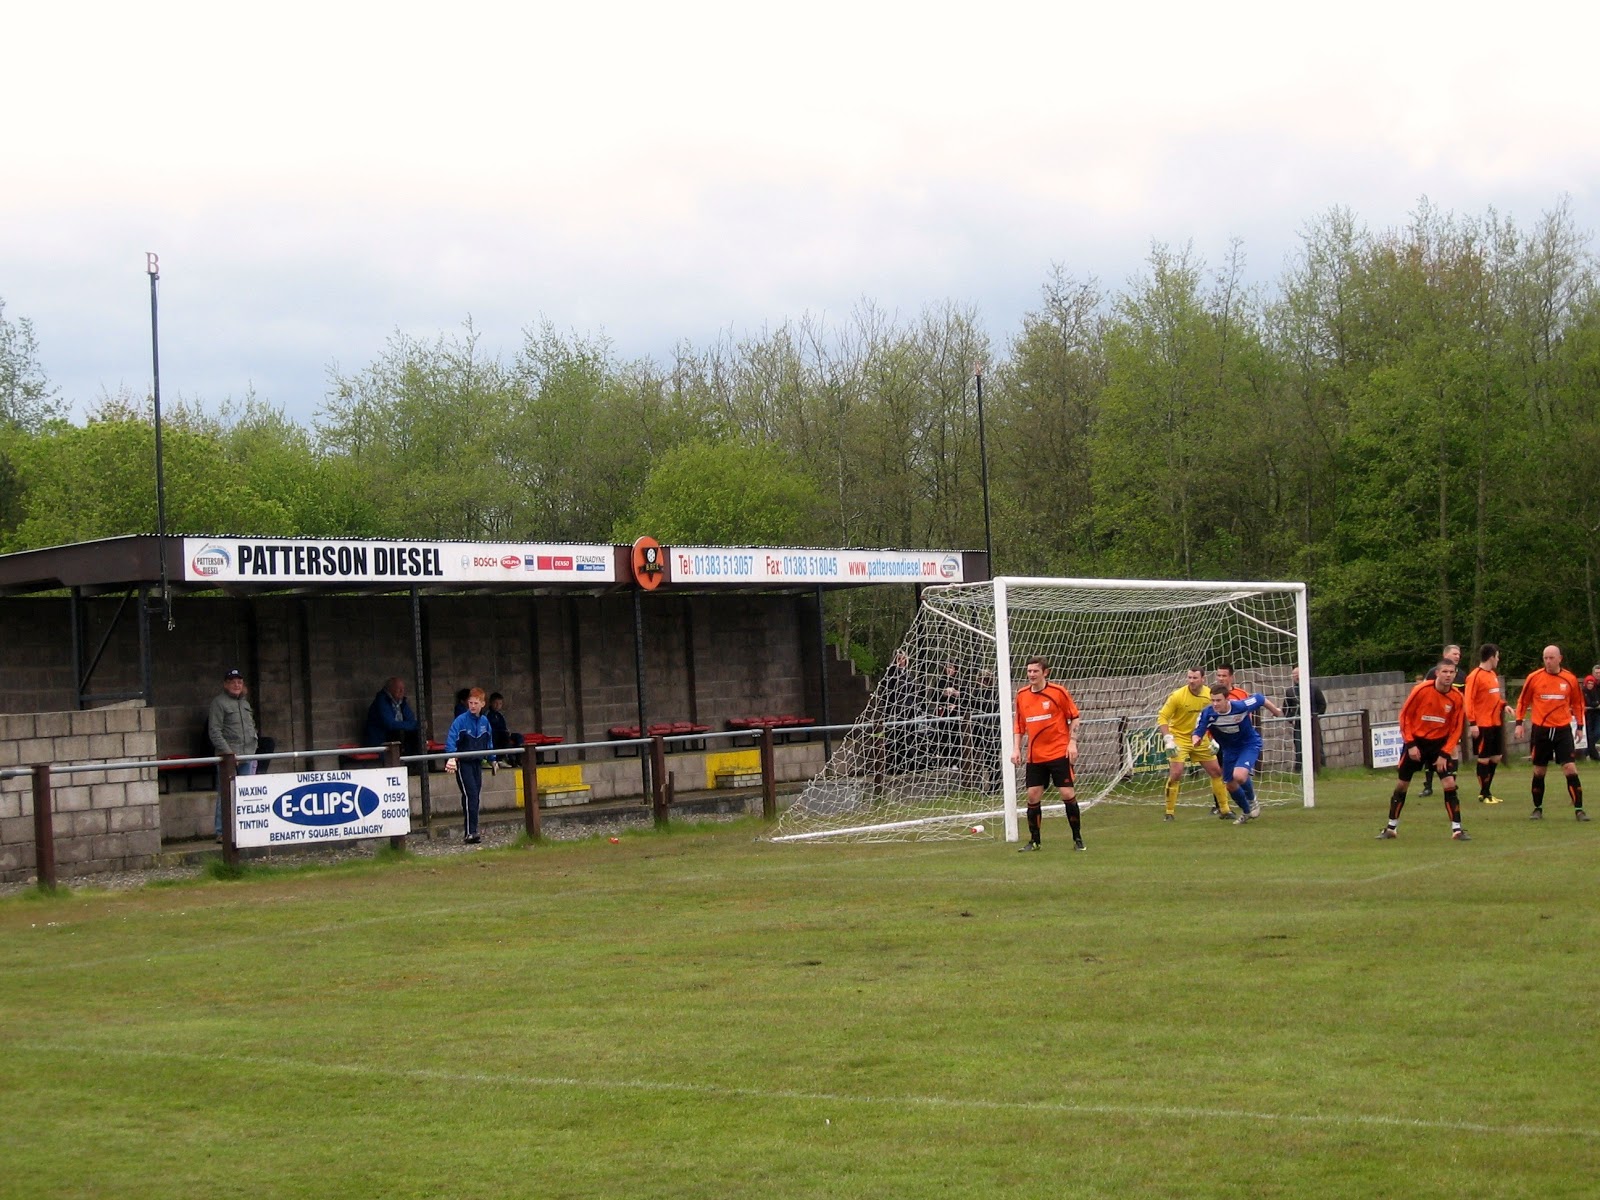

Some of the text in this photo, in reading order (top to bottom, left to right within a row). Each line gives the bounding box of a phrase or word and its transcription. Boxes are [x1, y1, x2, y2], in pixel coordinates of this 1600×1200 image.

[196, 557, 224, 566] PATTERSON
[237, 545, 368, 576] PATTERSON
[373, 547, 443, 576] DIESEL
[473, 557, 498, 567] BOSCH
[575, 555, 606, 563] STANADYNE
[202, 566, 219, 575] DIESEL
[678, 555, 838, 576] Tel: 01383 513057 Fax: 01383 518045
[848, 557, 937, 580] www.pattersondiesel.com
[297, 771, 352, 783] UNISEX SALON
[386, 777, 401, 786] TEL
[238, 786, 268, 797] WAXING
[383, 792, 406, 803] 01592
[236, 804, 270, 815] EYELASH
[381, 808, 410, 819] 860001
[239, 819, 269, 830] TINTING
[269, 824, 384, 842] BENARTY SQUARE, BALLINGRY
